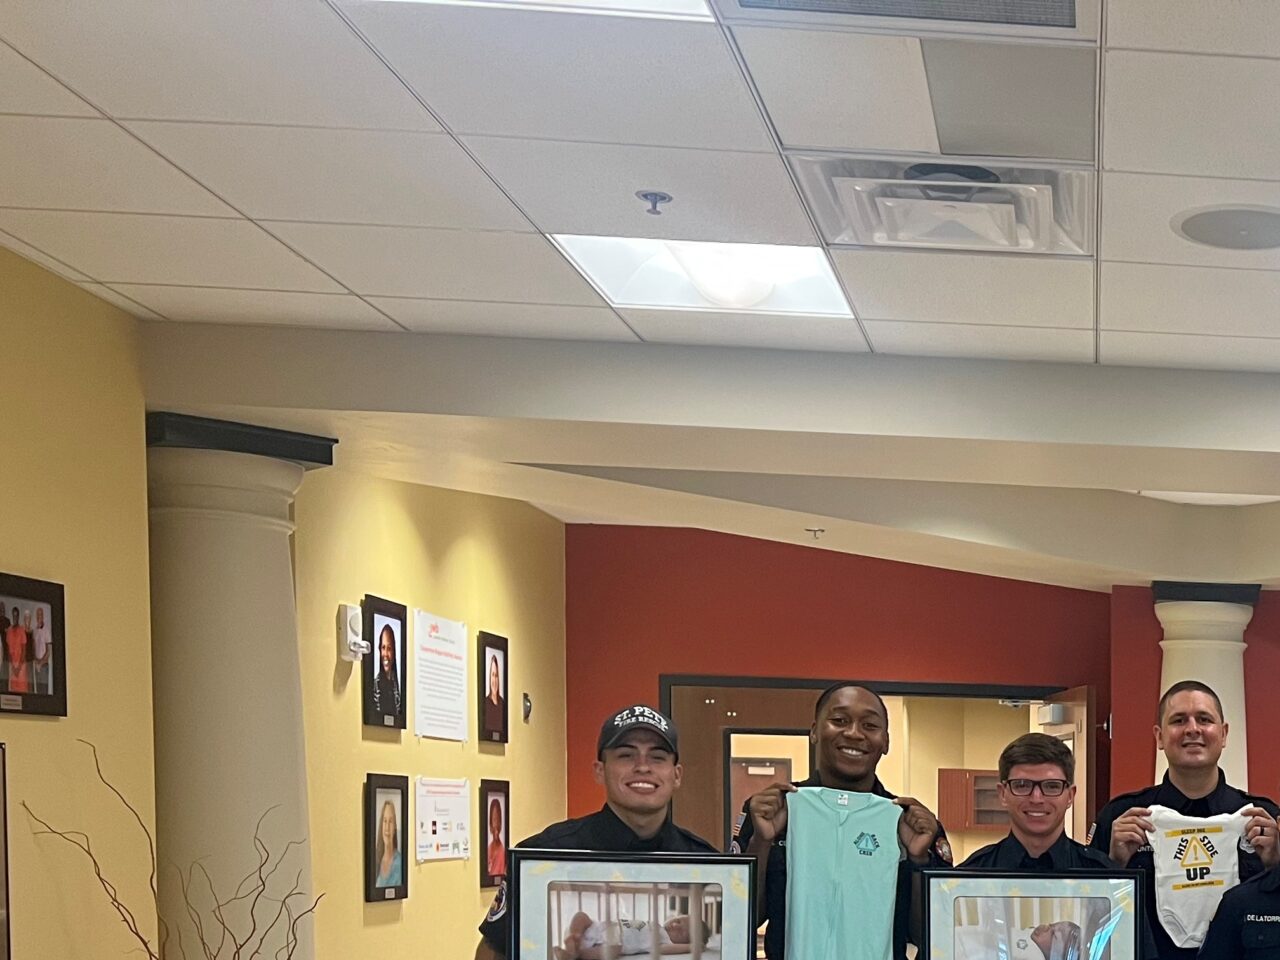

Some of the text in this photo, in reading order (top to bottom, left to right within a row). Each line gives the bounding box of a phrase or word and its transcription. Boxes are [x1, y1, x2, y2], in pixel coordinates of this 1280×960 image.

[614, 706, 668, 730] ST. PETE
[1173, 837, 1189, 860] THIS
[1200, 835, 1218, 858] SIDE
[1186, 867, 1210, 881] UP
